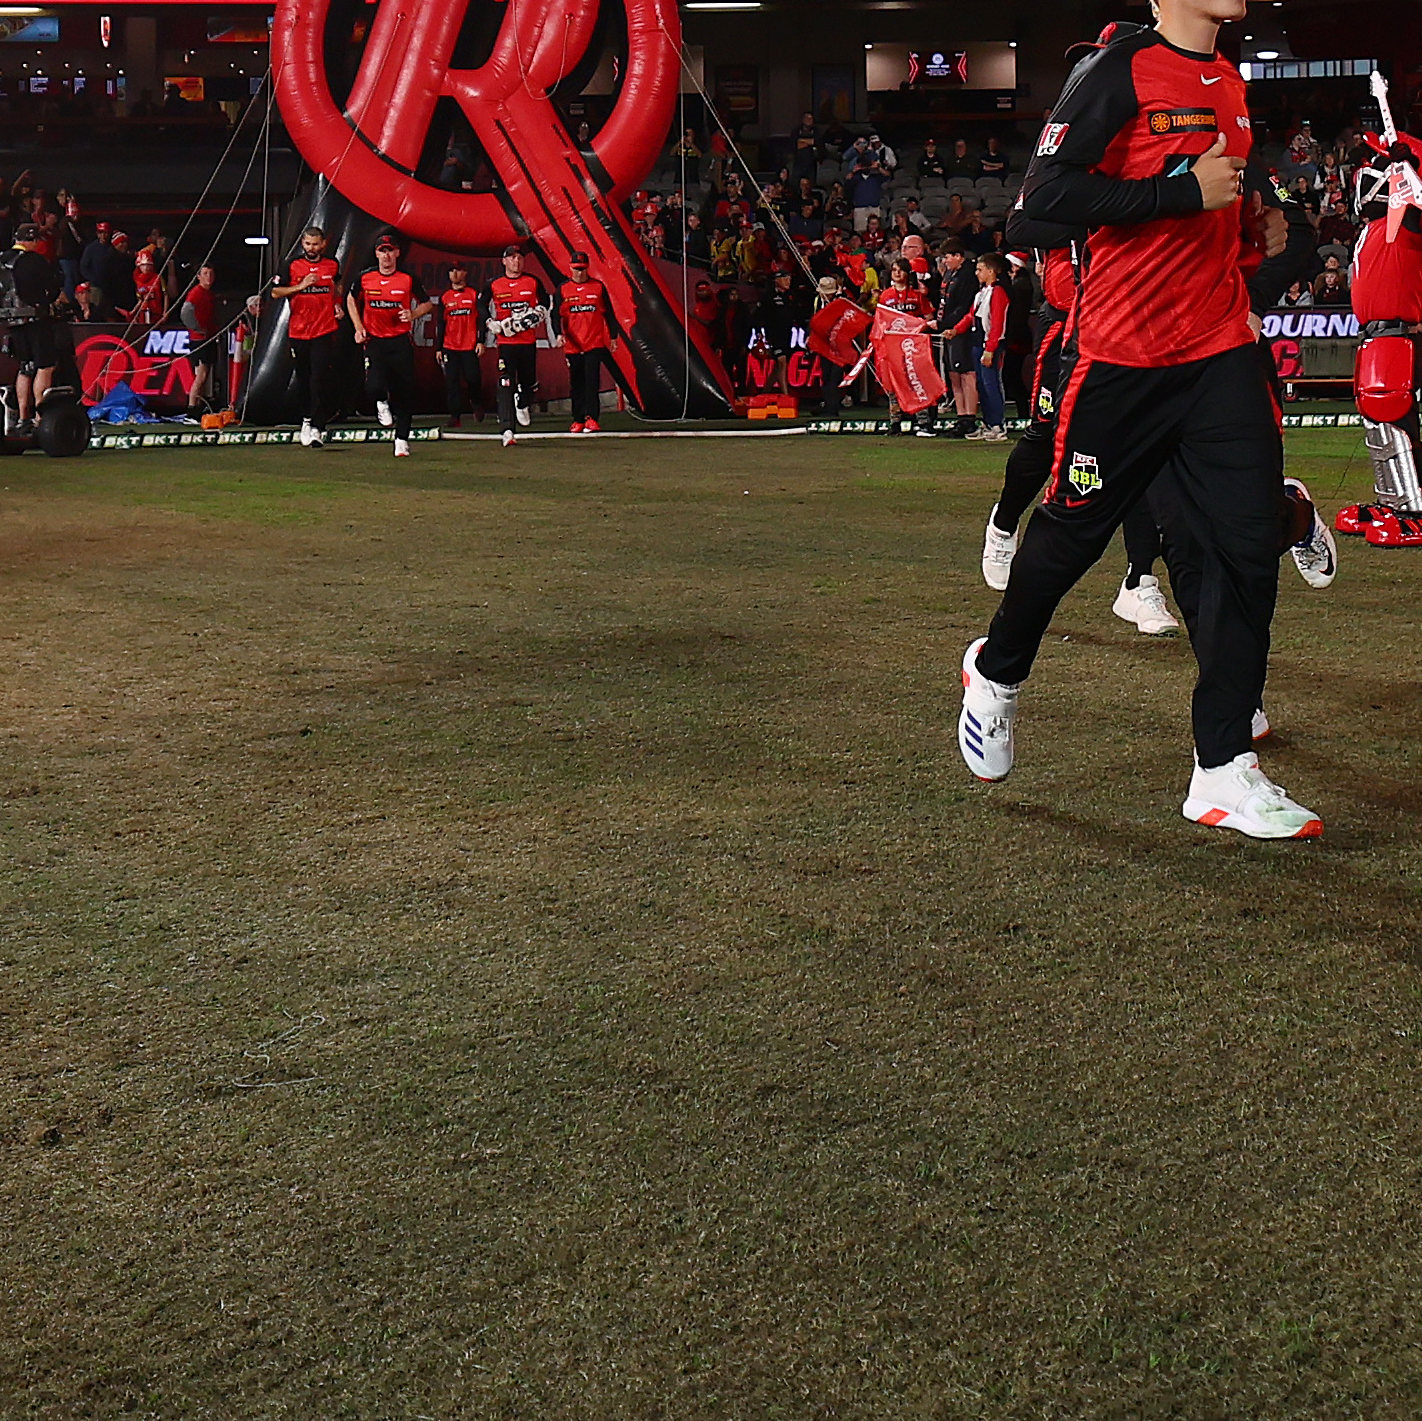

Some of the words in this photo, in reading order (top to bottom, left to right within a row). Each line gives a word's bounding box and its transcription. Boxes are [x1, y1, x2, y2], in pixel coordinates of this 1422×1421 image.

[1301, 414, 1336, 426] BKT
[104, 436, 140, 448] BKT
[142, 434, 179, 447] BKT
[180, 433, 216, 445] BKT
[217, 432, 254, 444] BKT
[255, 431, 291, 443] BKT
[1070, 467, 1101, 486] BBL
